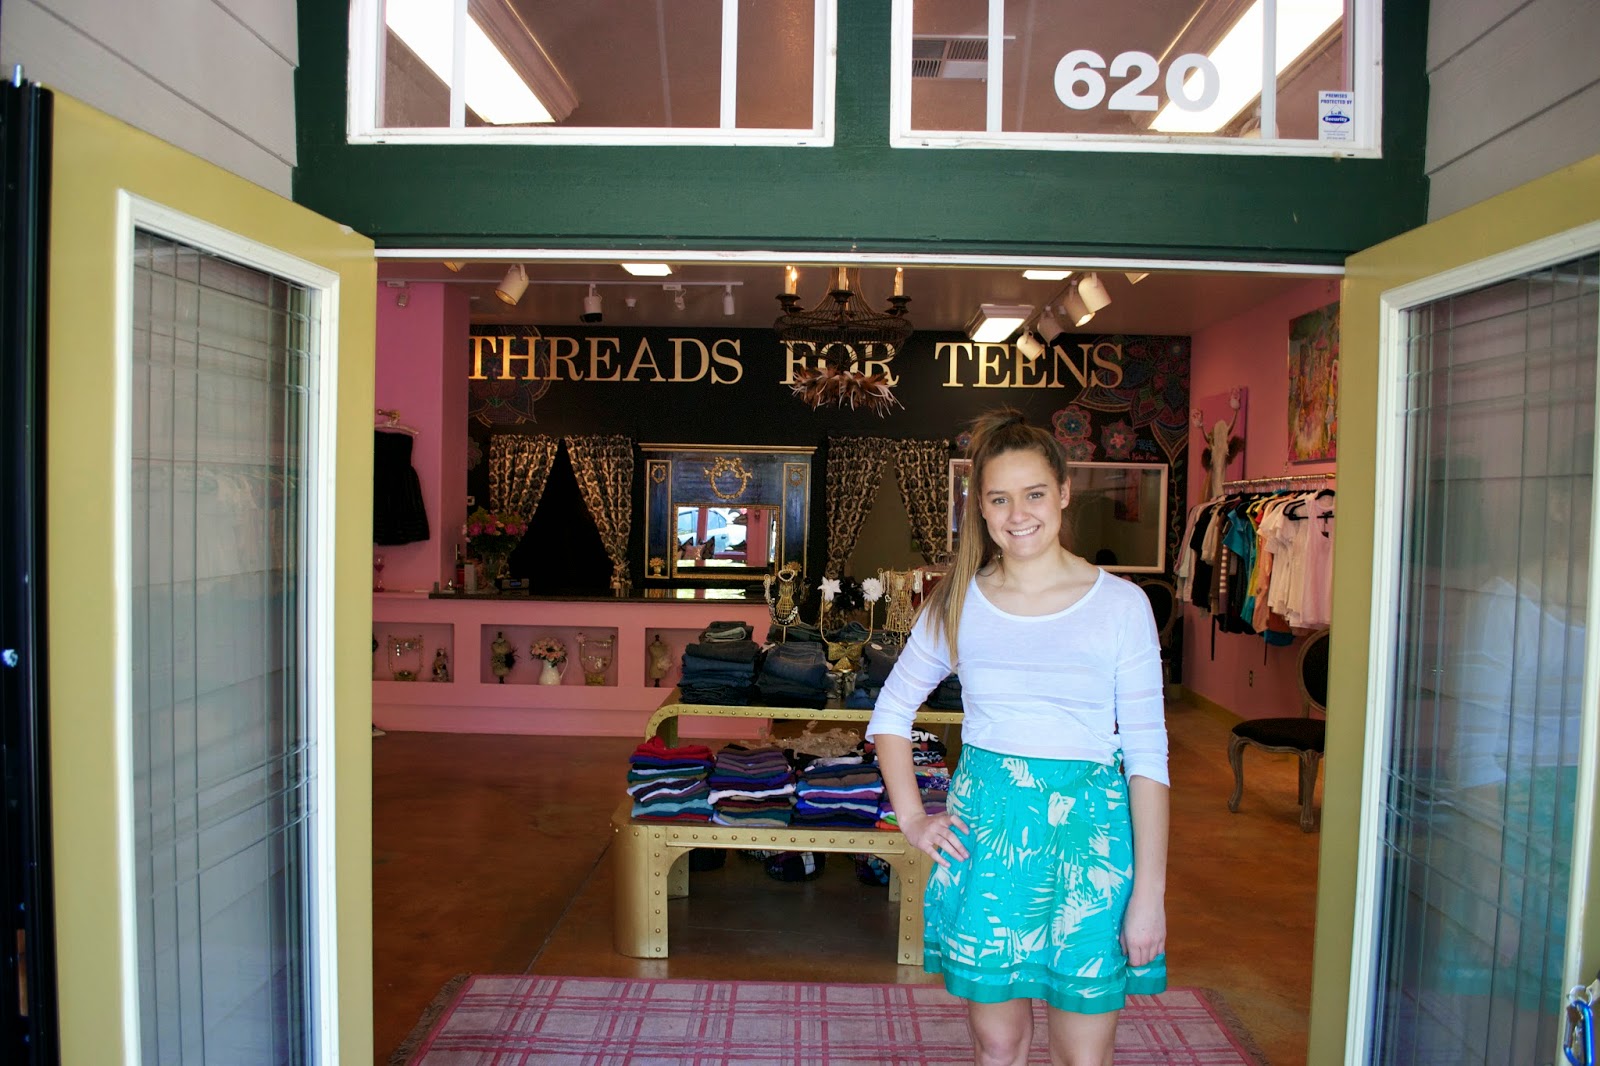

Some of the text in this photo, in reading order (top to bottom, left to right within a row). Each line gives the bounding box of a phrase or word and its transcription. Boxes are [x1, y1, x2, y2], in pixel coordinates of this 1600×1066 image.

[1054, 49, 1220, 112] 620
[469, 336, 1123, 389] THREADS FOR TEENS
